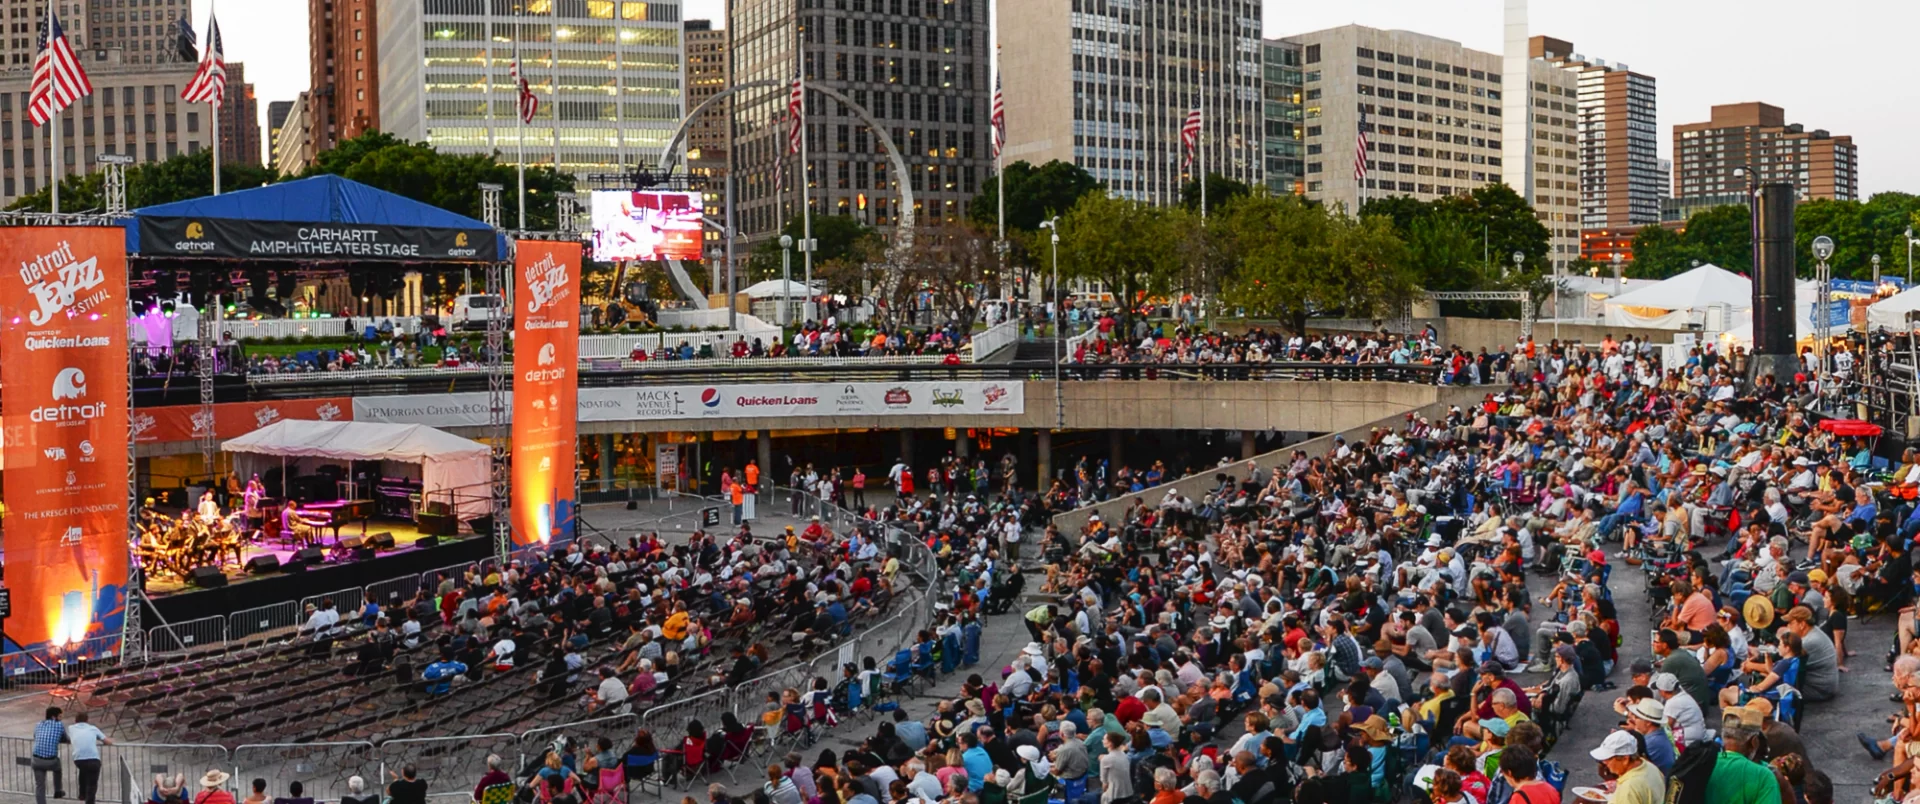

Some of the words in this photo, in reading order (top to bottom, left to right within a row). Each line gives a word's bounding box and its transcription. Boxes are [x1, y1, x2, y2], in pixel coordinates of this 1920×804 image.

[298, 228, 378, 242] CARHARTT
[175, 241, 215, 250] detroit
[250, 240, 371, 255] AMPHITHEATER
[373, 244, 420, 256] STAGE
[448, 248, 476, 257] detroit
[20, 240, 76, 286] detroit
[525, 252, 555, 284] detroit
[66, 288, 110, 320] FESTIVAL
[25, 336, 74, 351] Quicken
[75, 335, 110, 347] Loans
[525, 368, 565, 382] detroit
[637, 391, 671, 401] MACK
[737, 396, 782, 407] Quicken
[783, 395, 818, 405] Loans
[463, 404, 471, 414] &
[637, 401, 671, 409] AVENUE
[637, 408, 672, 416] RECORDS
[30, 402, 107, 423] detroit
[44, 448, 66, 461] WJR
[24, 511, 38, 520] THE
[40, 508, 68, 519] KRESGE
[69, 504, 119, 515] FOUNDATION
